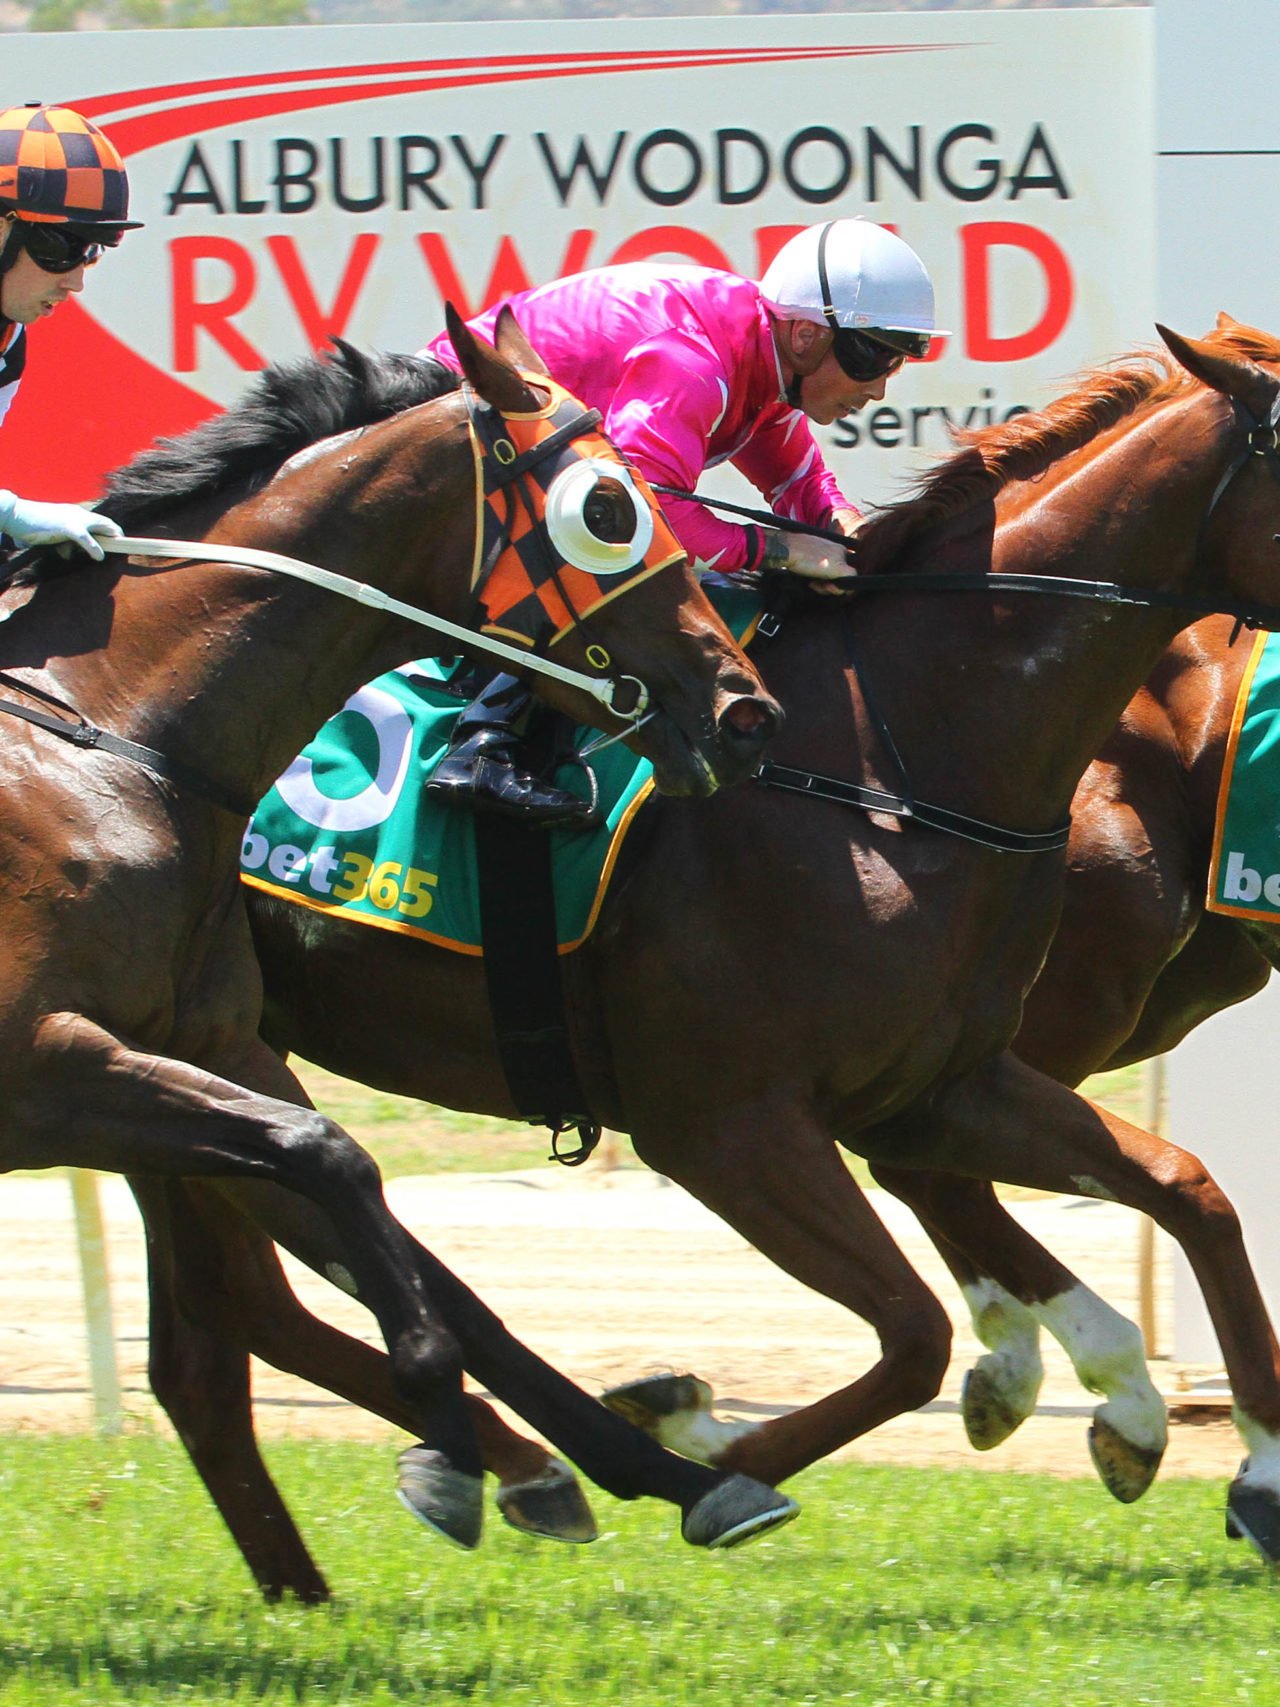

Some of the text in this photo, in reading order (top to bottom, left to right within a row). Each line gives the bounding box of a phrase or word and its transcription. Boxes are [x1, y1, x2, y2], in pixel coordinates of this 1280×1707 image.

[165, 122, 1072, 215] ALBURY WODONGA
[168, 232, 382, 372] RV
[239, 815, 439, 918] bet365
